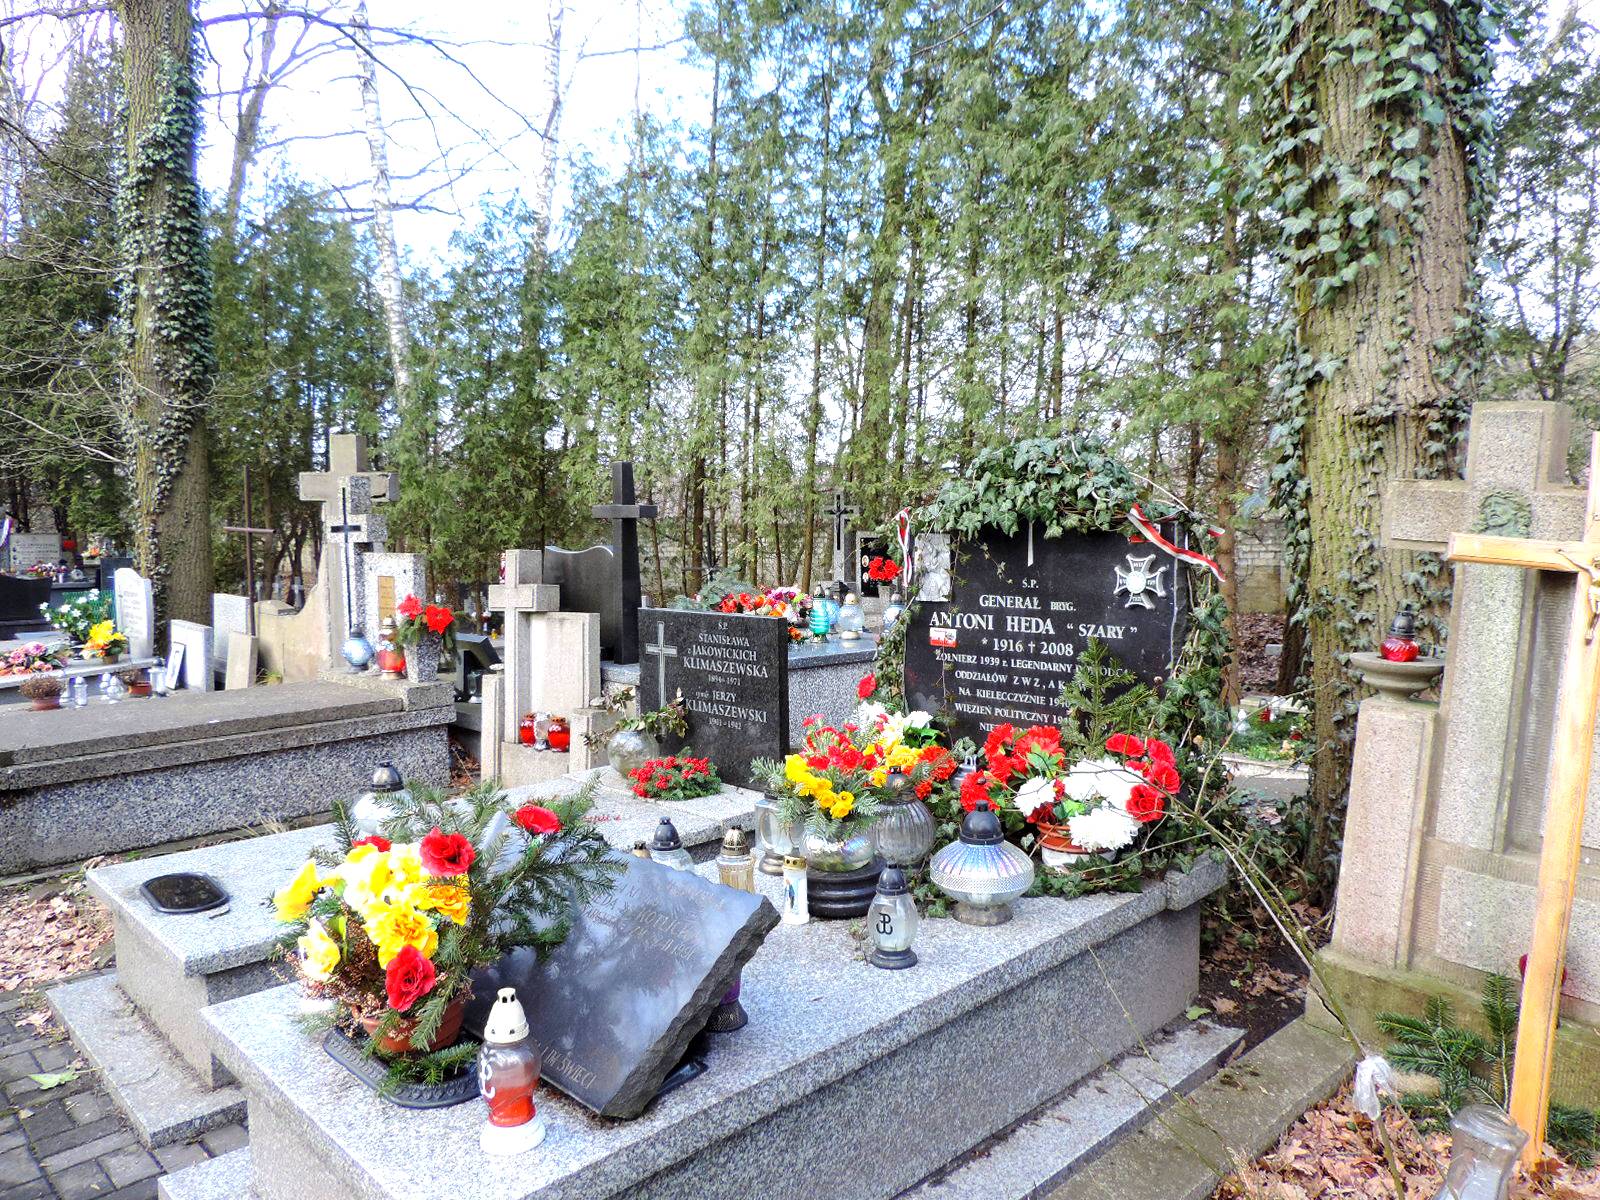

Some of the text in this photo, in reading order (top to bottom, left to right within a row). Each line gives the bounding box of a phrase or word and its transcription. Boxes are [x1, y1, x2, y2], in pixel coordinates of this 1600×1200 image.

[979, 594, 1077, 611] GENERAŁ BRYG.
[929, 611, 994, 630] ANTONI
[1005, 615, 1055, 635] HEDA
[698, 632, 750, 647] STANISŁAWA
[993, 638, 1074, 656] 1916 2008
[692, 644, 757, 661] JAKOWICKICH
[683, 656, 768, 678] KLIMASZEWSKA
[980, 656, 1000, 666] 1939
[1011, 658, 1073, 674] LEGENDARNY
[955, 670, 1008, 683] ODDZIAŁÓW
[712, 690, 737, 703] JERZY
[958, 686, 971, 696] NA
[685, 699, 768, 724] KLIMASZEWSKI
[994, 707, 1049, 723] POLITYCZNY
